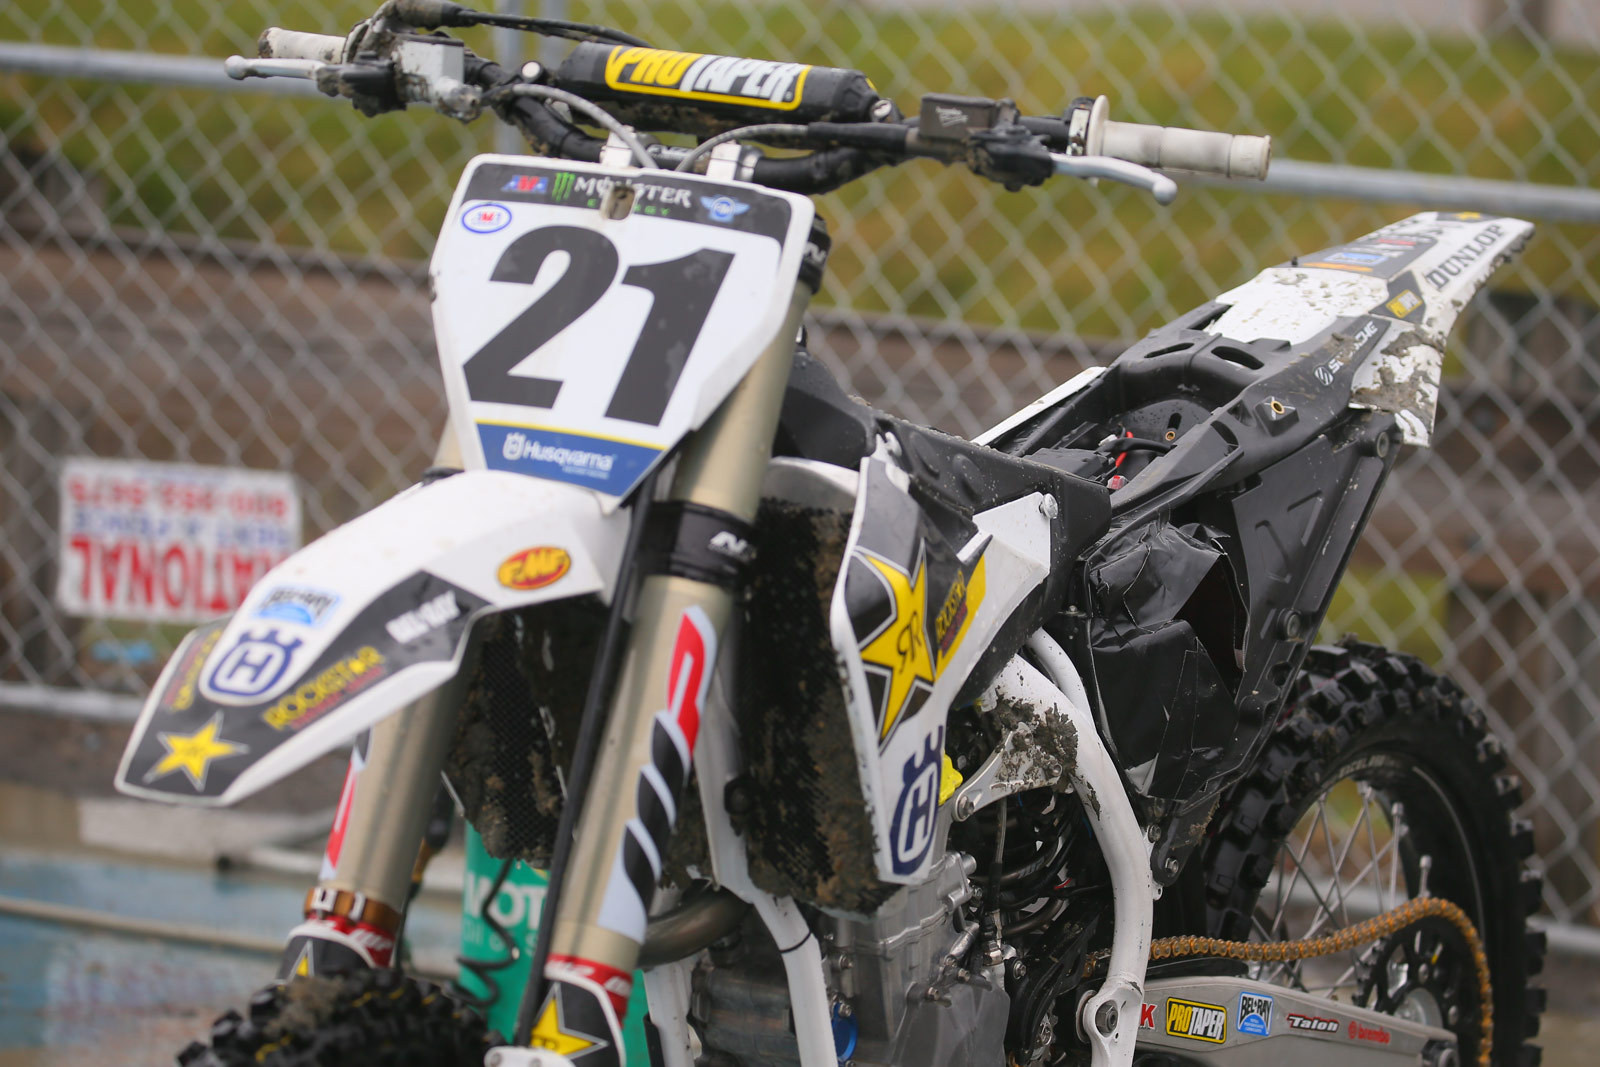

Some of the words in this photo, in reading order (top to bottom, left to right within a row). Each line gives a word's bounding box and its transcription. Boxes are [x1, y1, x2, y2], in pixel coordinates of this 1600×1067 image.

[574, 176, 692, 207] MOSTER
[1426, 224, 1504, 290] DUNLOP
[462, 224, 737, 427] 21
[522, 440, 614, 471] Husqvarna
[71, 536, 285, 610] ATIONAL
[1168, 1003, 1225, 1041] PROTAPER
[1287, 1014, 1340, 1033] Talon
[1357, 1022, 1391, 1045] brembo
